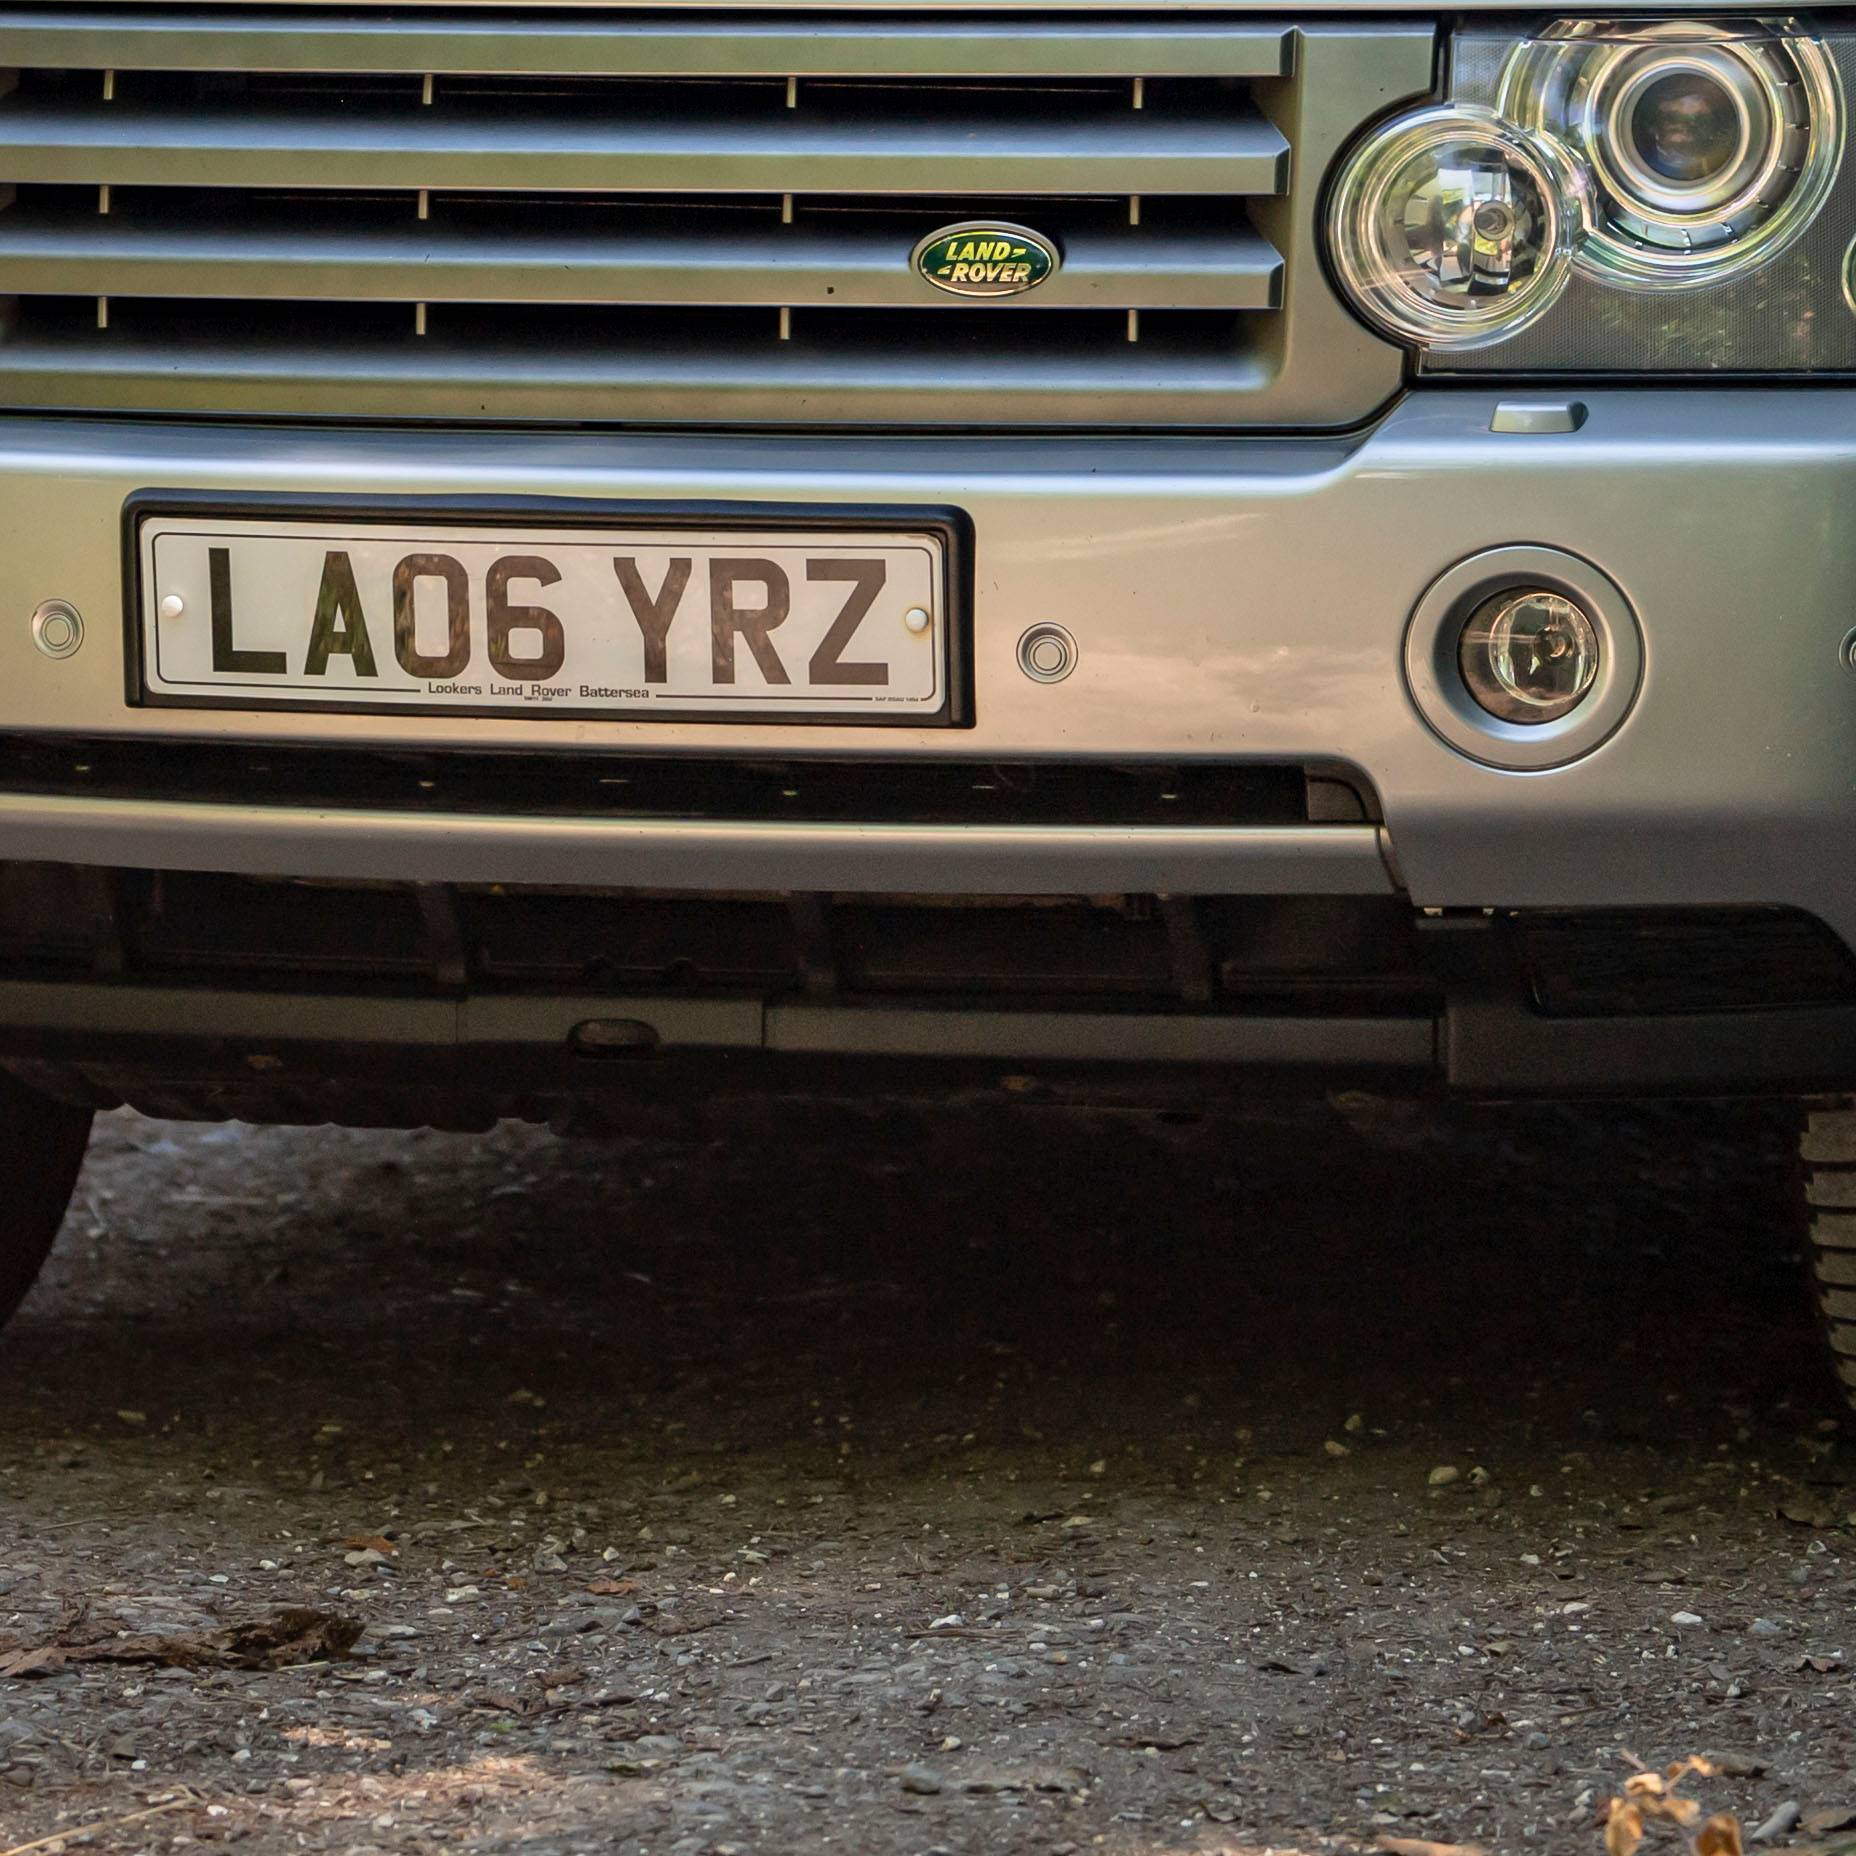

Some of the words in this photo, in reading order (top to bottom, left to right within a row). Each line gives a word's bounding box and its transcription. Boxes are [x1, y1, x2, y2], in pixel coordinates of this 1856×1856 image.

[946, 242, 1011, 261] LAND
[950, 263, 1032, 282] ROVER
[208, 547, 566, 681] LA06
[613, 557, 890, 685] YRZ
[428, 682, 482, 695] Lookers
[490, 683, 523, 696] Land
[531, 684, 572, 697] Rover
[579, 685, 650, 699] Battersea
